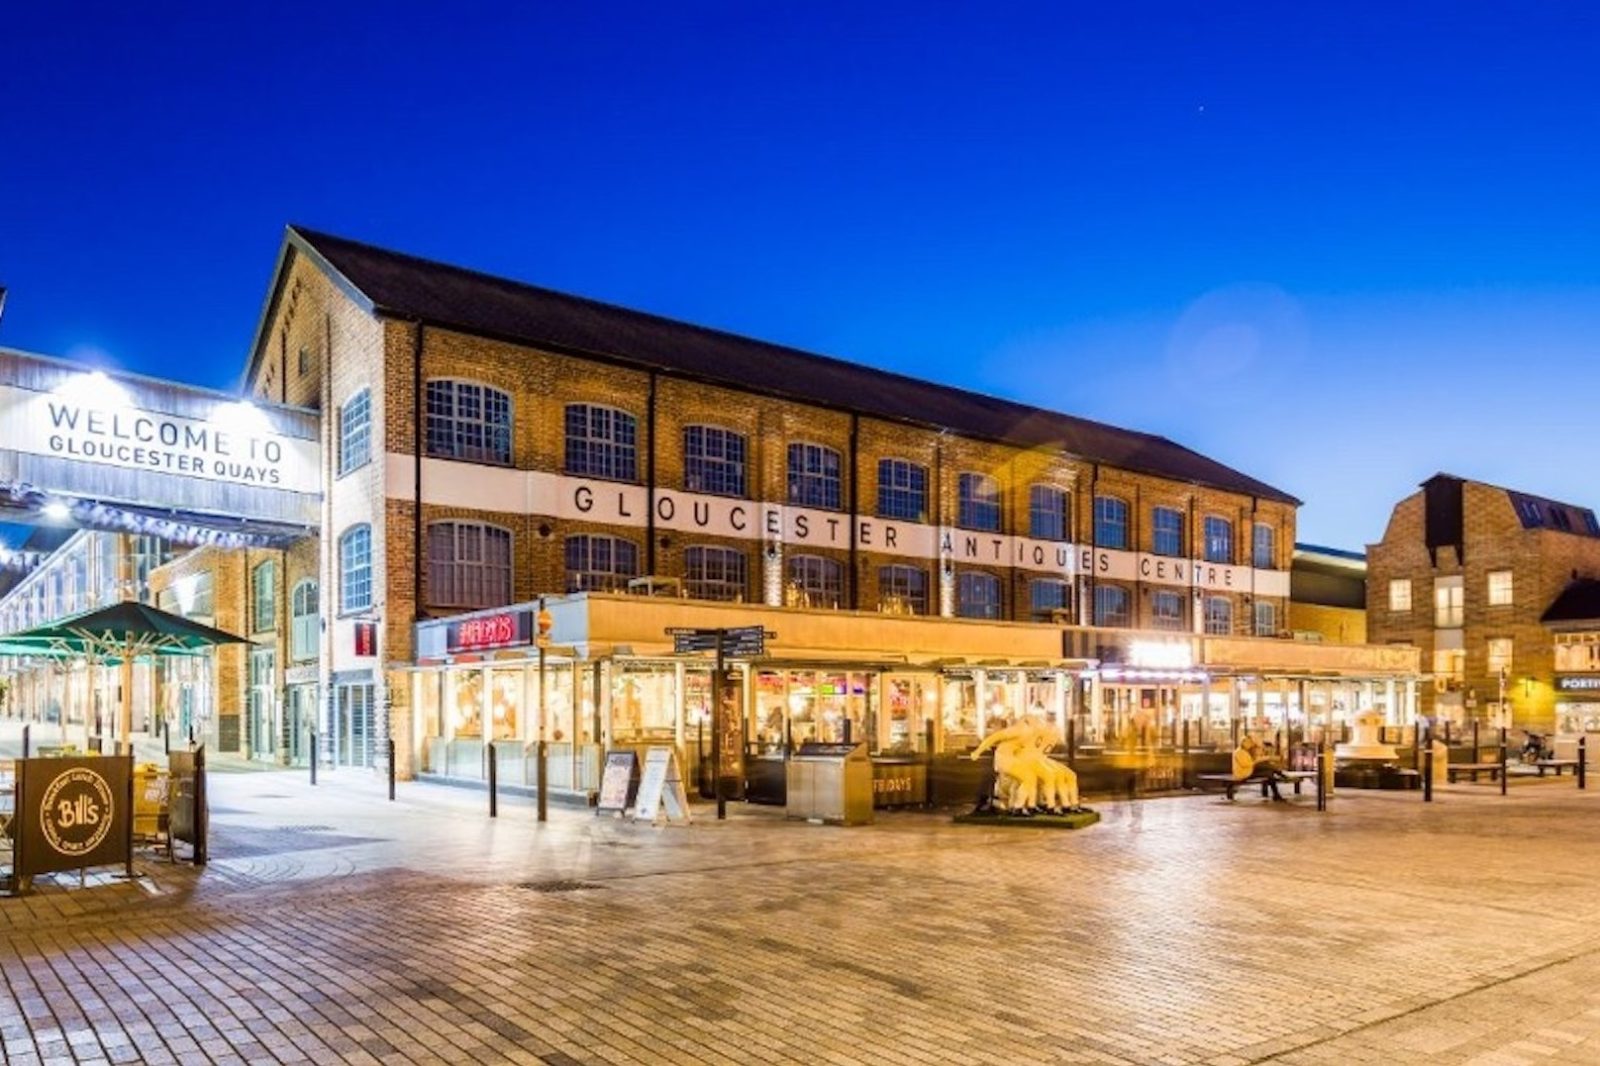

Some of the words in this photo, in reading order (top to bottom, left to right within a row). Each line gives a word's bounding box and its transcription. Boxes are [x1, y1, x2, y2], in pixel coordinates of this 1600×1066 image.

[49, 402, 230, 456] WELCOME
[246, 437, 282, 463] TO
[50, 434, 205, 473] GLOUCESTER
[213, 460, 280, 484] QUAYS
[574, 486, 898, 548] GLOUCESTER
[941, 531, 1110, 572] ANTIQUES
[1140, 558, 1232, 587] CENTRE
